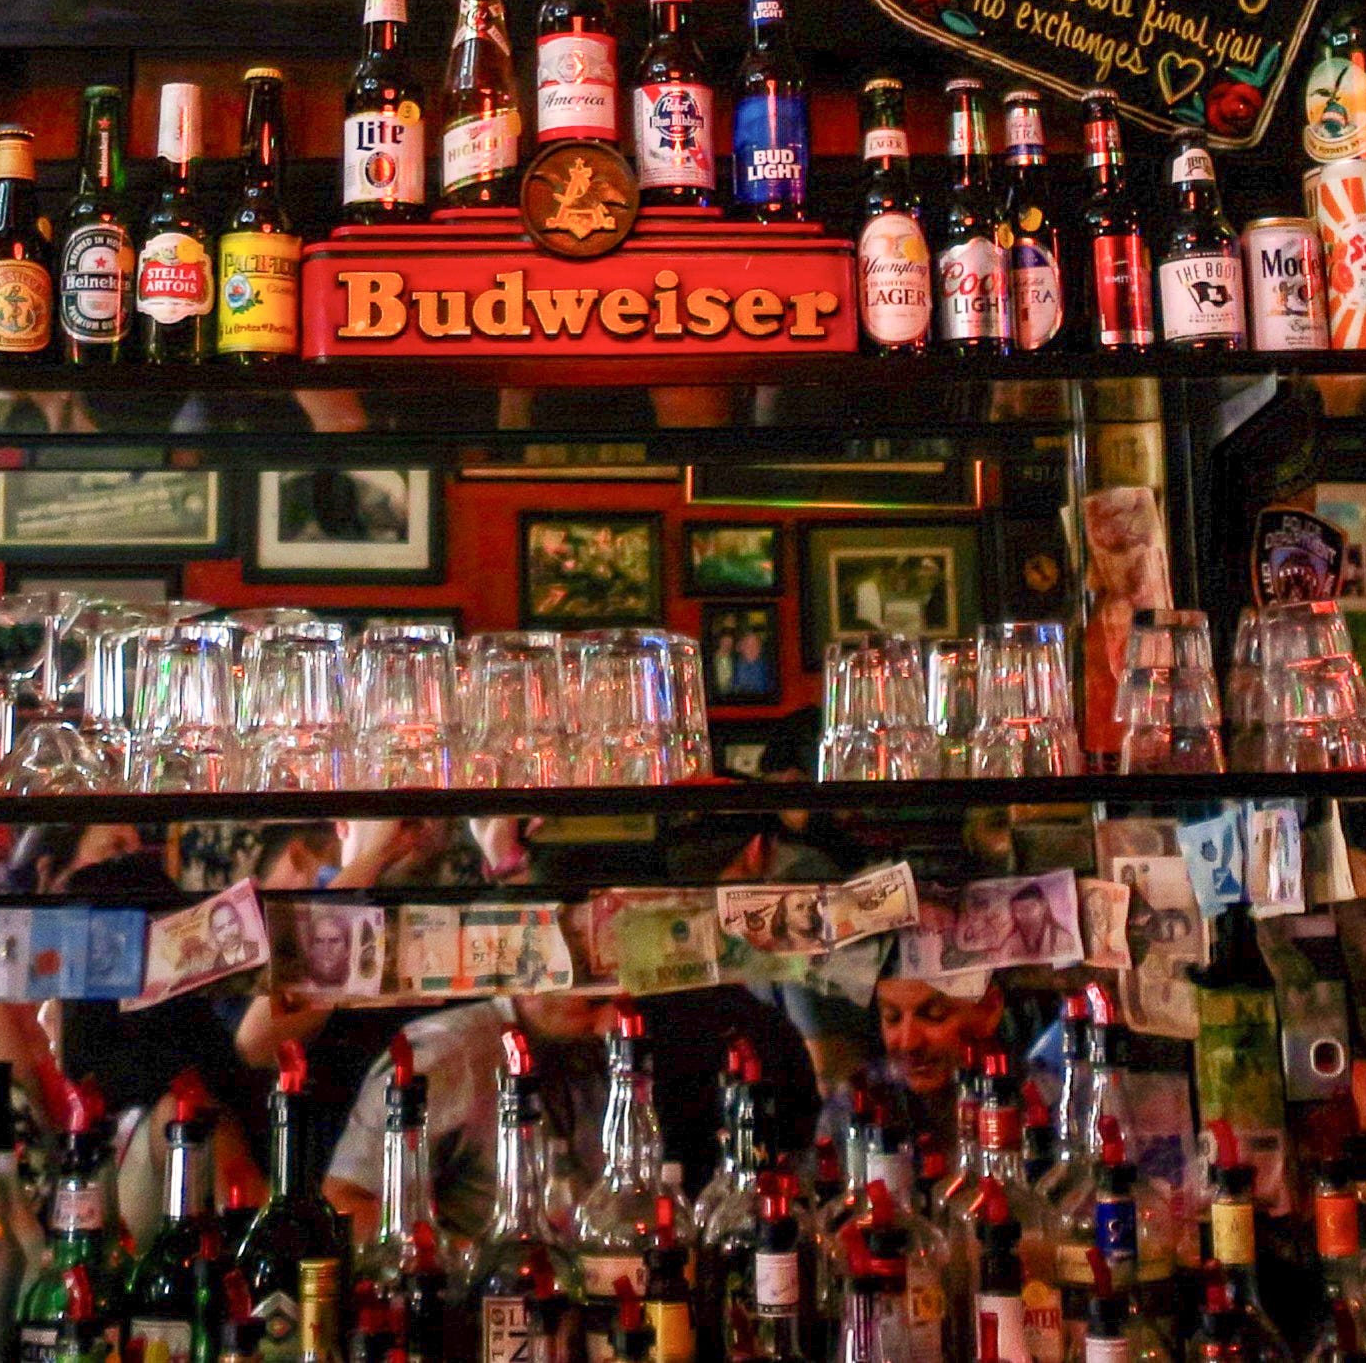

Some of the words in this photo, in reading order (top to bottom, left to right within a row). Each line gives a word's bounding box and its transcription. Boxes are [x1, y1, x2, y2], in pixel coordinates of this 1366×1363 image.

[544, 92, 606, 110] America
[355, 120, 405, 151] Lite
[868, 138, 904, 152] LAGER
[753, 148, 796, 166] BUD
[747, 164, 802, 182] LIGHT
[146, 267, 197, 281] STELLA
[861, 254, 928, 279] Yuengling
[1175, 262, 1206, 284] THE
[145, 280, 197, 294] ARTOIS
[337, 269, 838, 338] Budweiser
[864, 288, 927, 308] LAGER
[1282, 514, 1325, 535] POLICE
